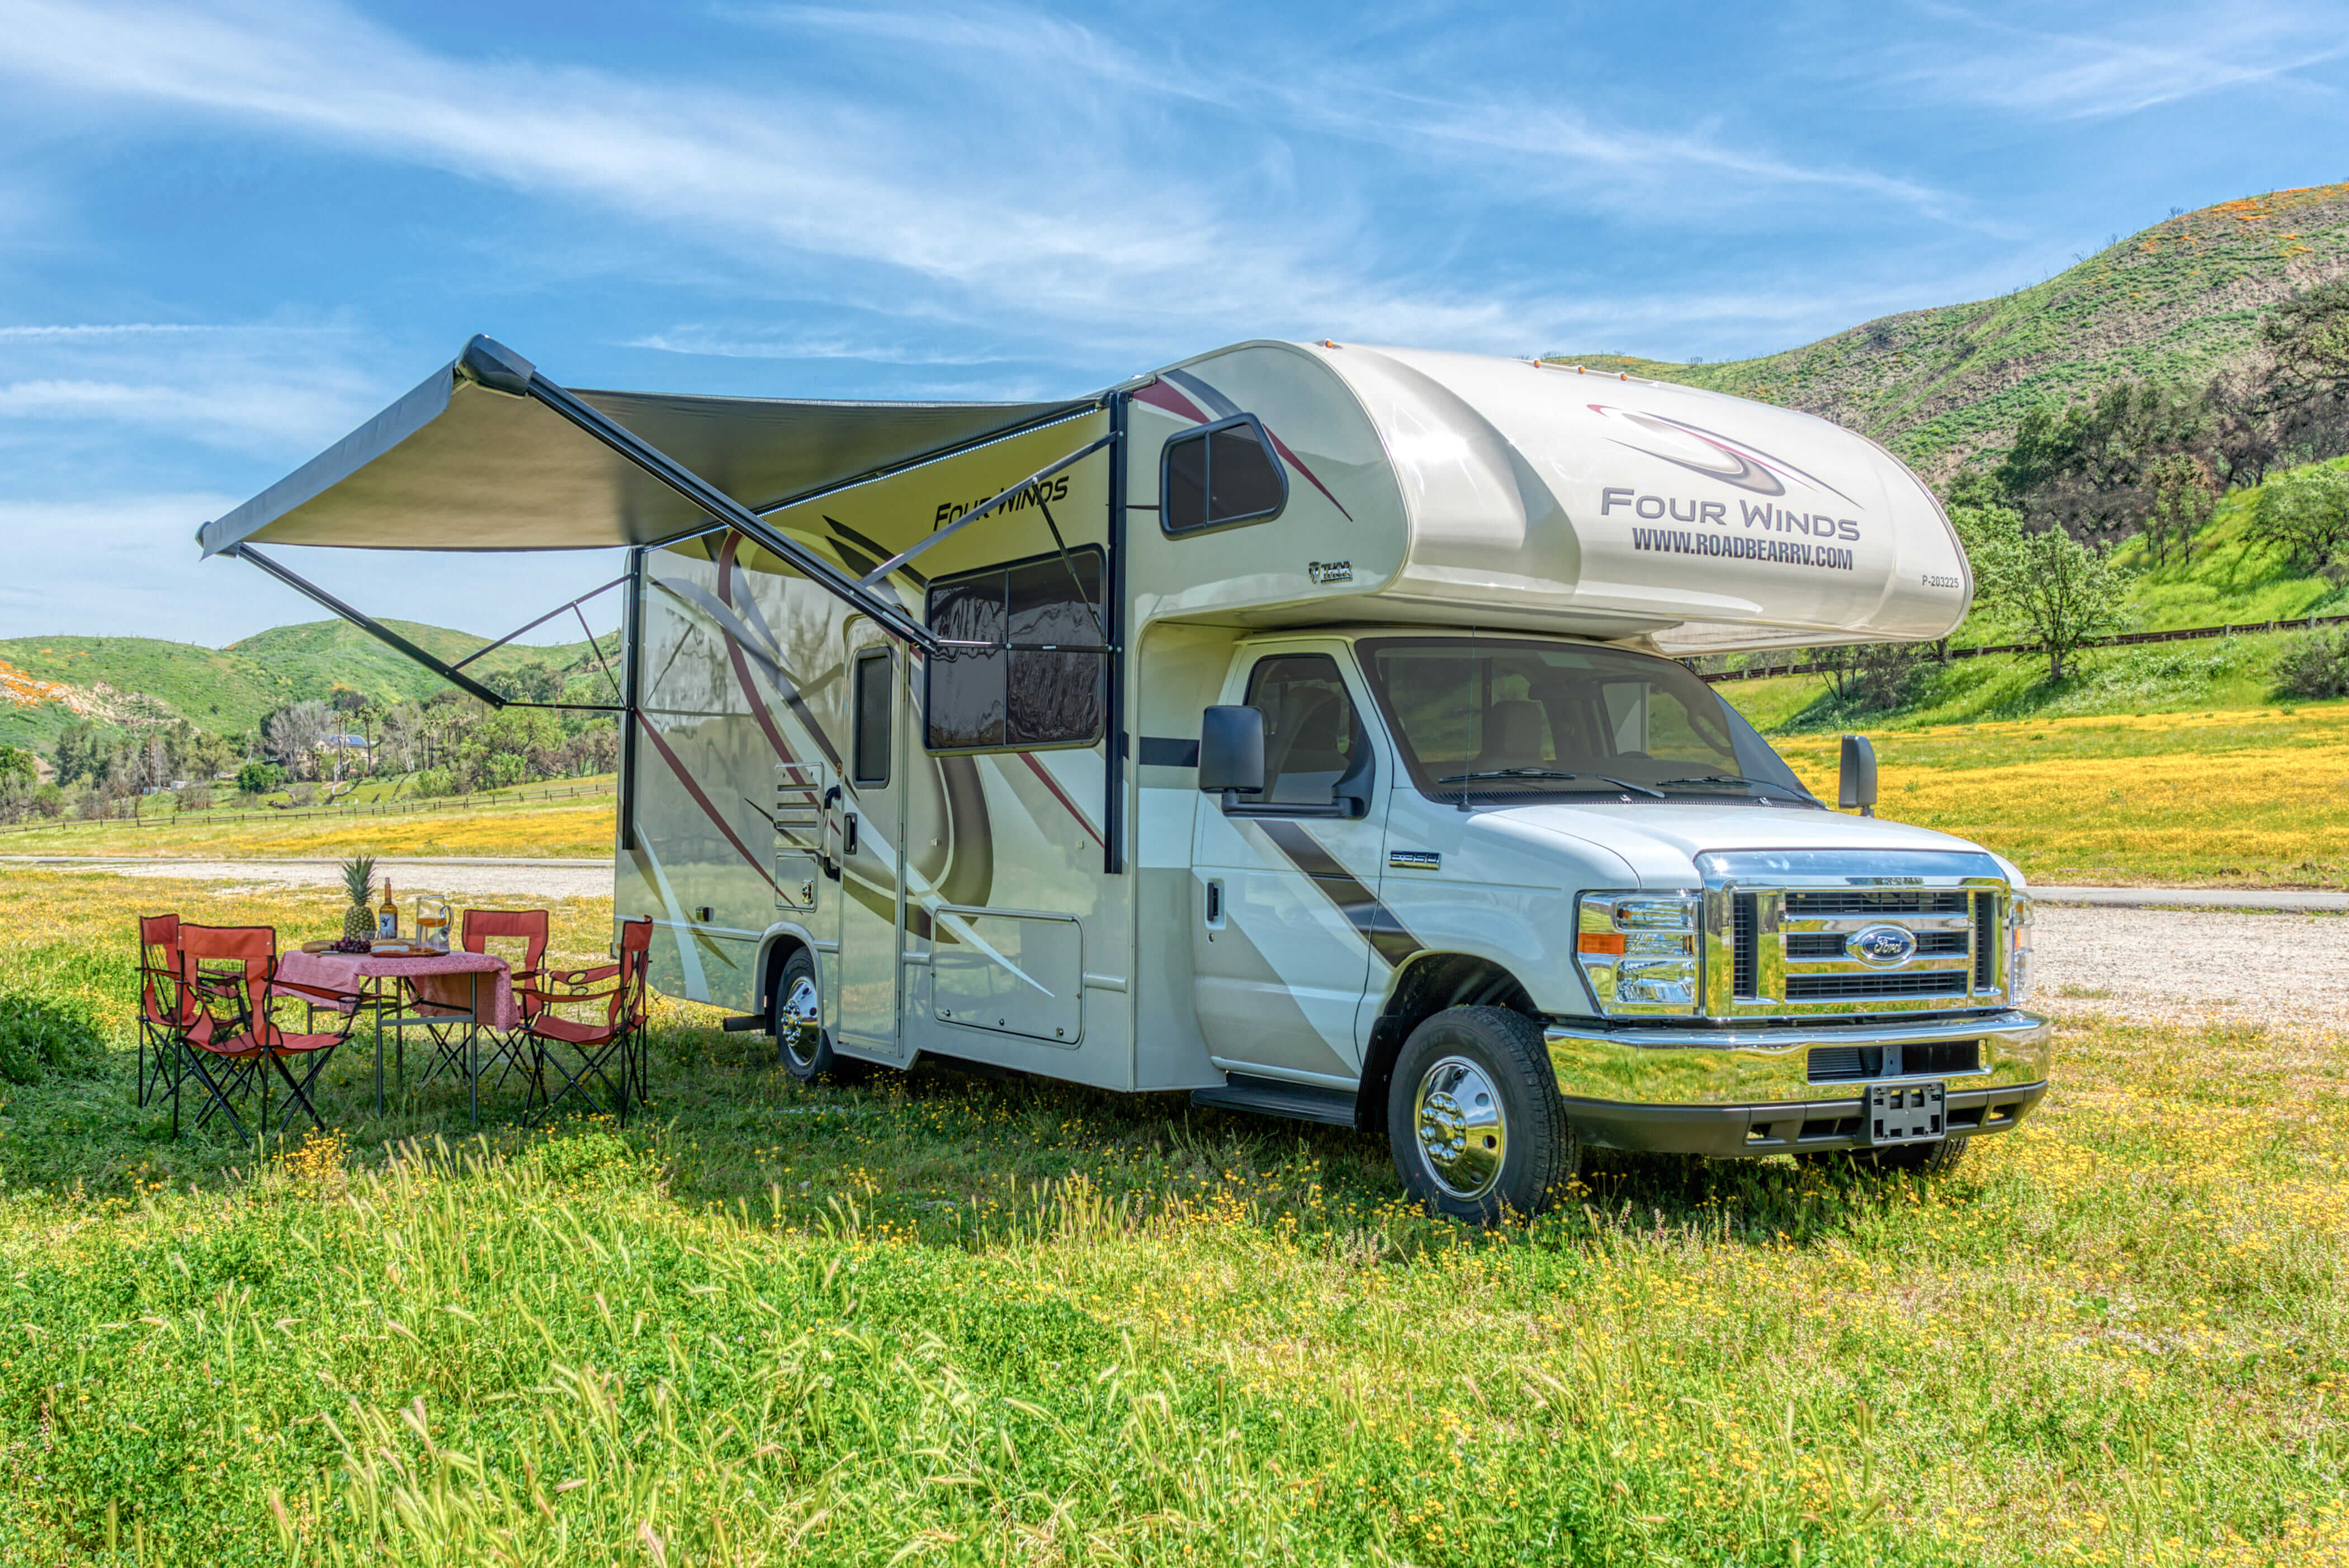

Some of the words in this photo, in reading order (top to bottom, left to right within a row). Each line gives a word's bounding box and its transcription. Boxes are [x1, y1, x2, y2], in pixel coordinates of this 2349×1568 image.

[1601, 487, 1727, 526] FOUR
[1739, 499, 1860, 541] WINDS
[1632, 527, 1853, 570] WWW.ROADBEARRV.COM
[1922, 575, 1959, 588] P-203225
[1874, 936, 1902, 953] Ford
